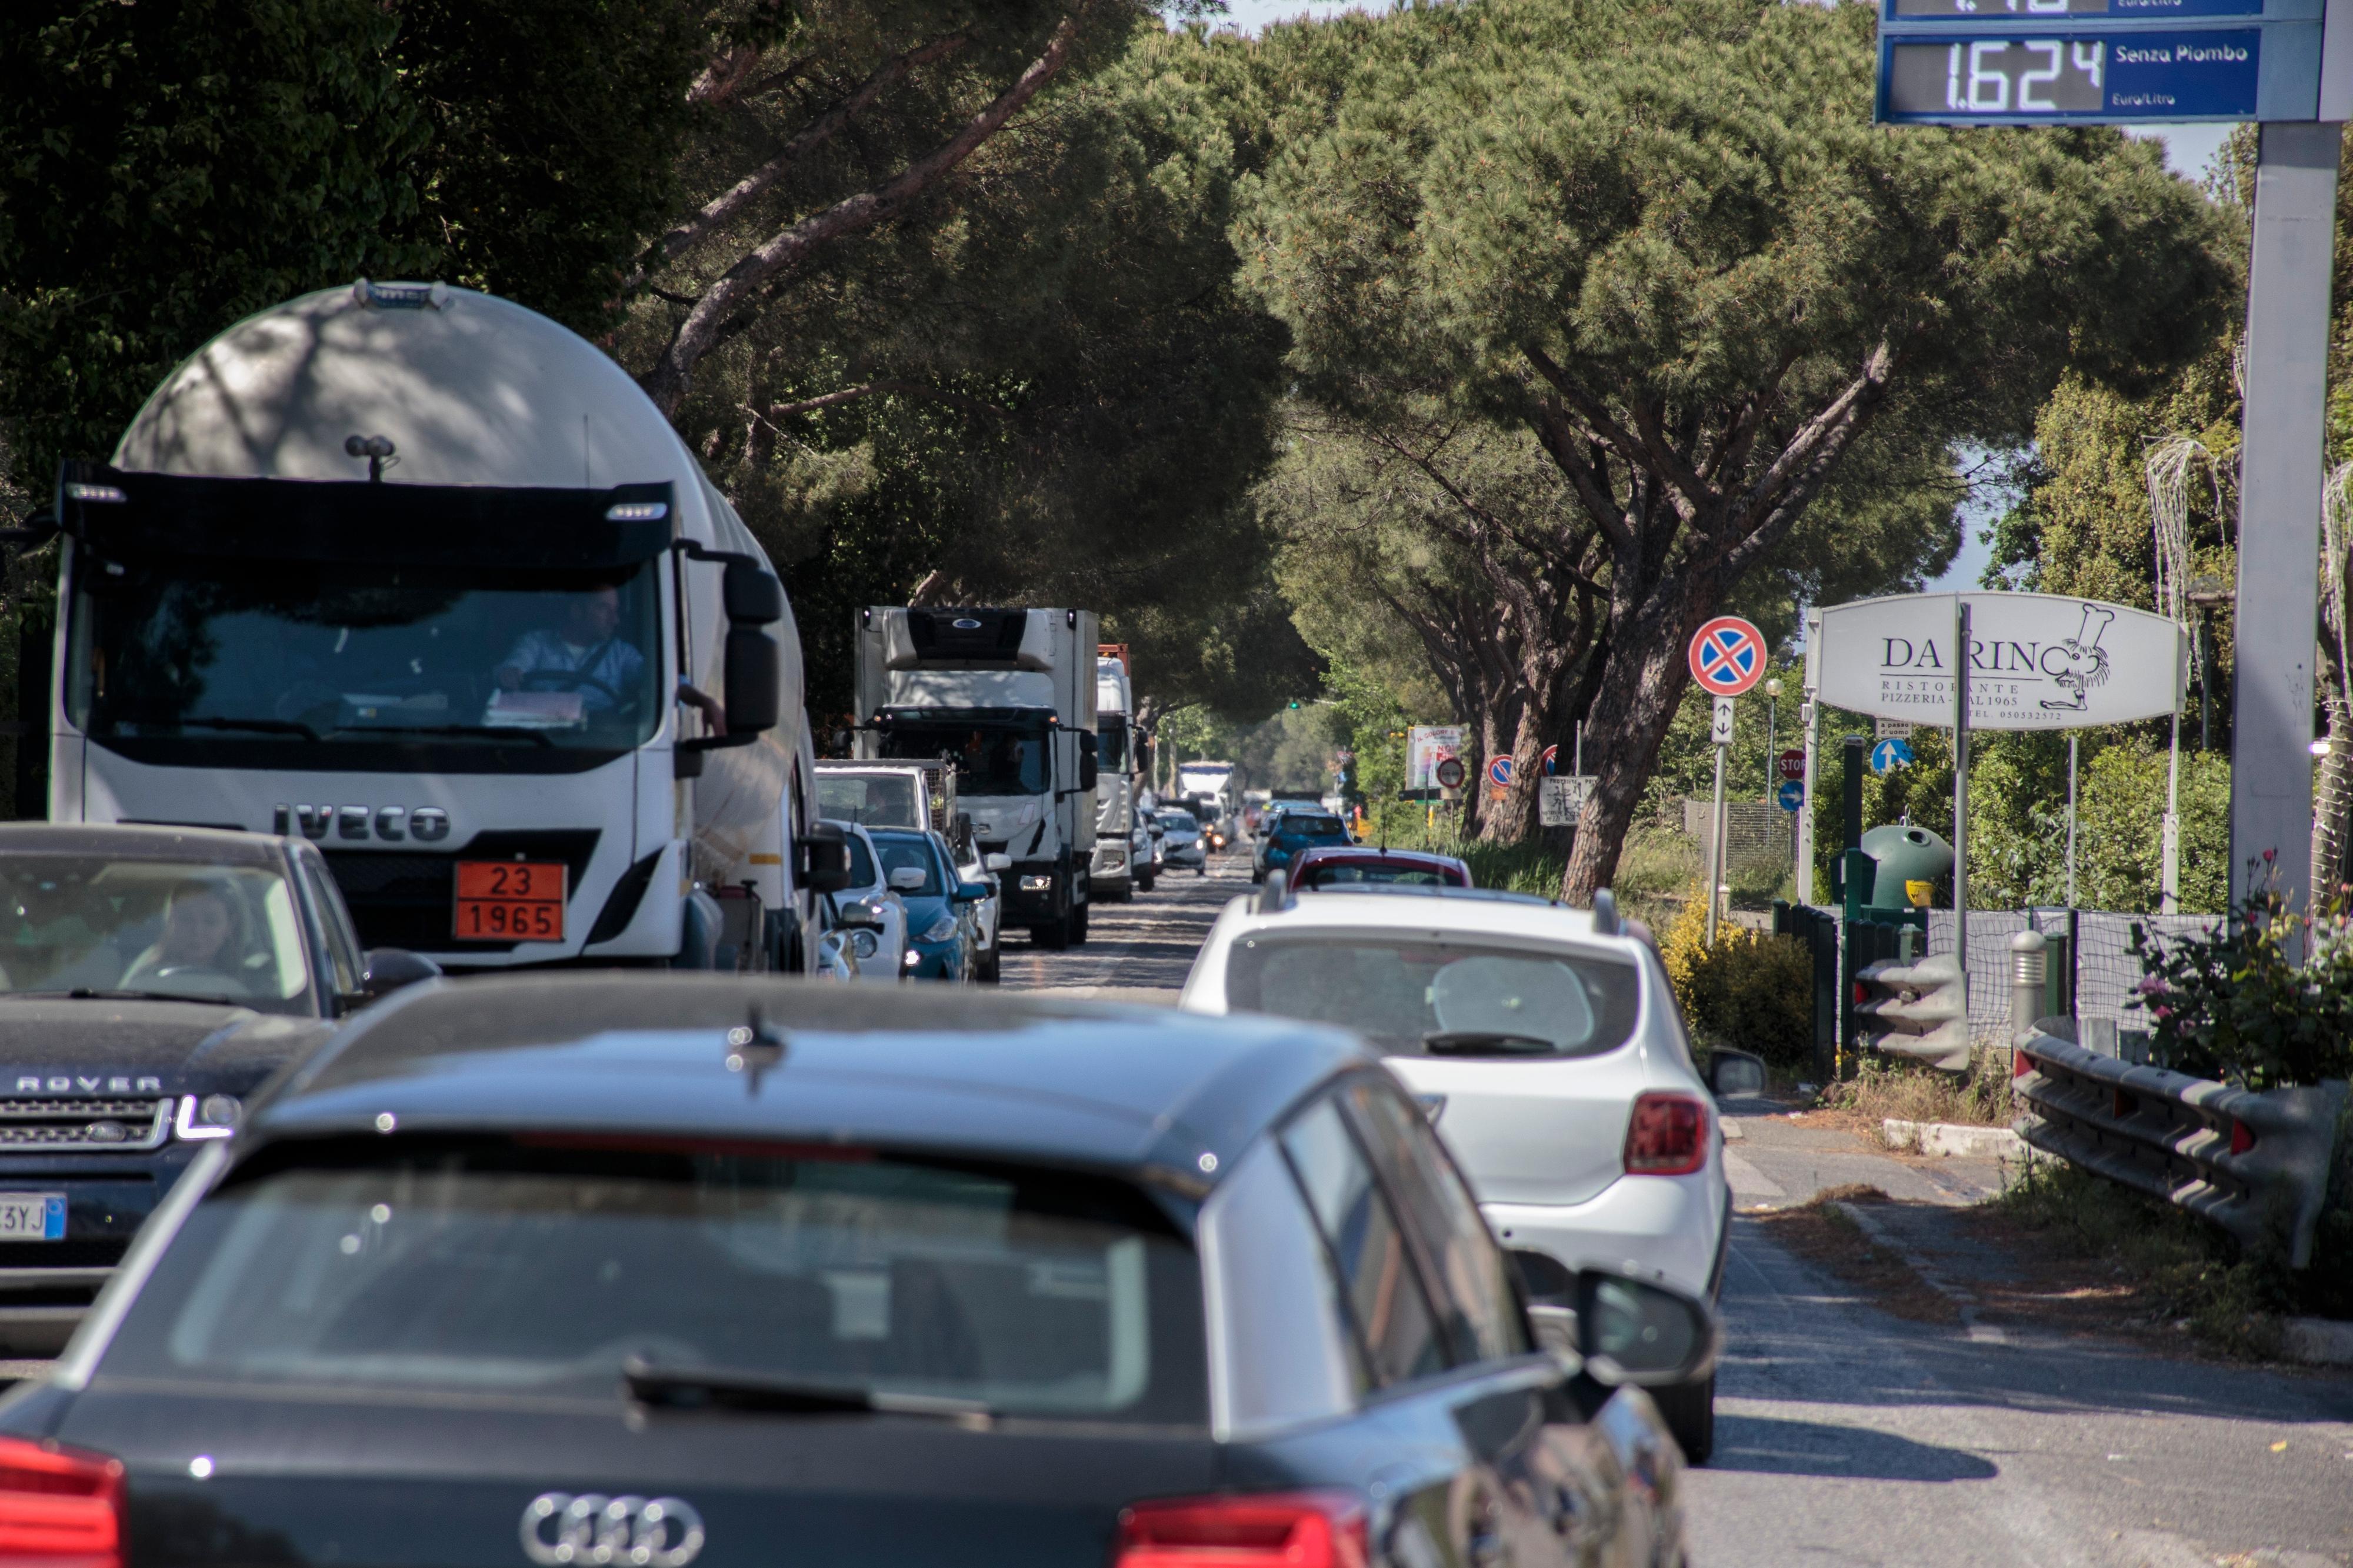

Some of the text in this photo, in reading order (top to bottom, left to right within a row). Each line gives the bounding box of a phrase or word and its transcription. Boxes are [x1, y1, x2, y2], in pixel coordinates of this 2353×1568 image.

[2116, 45, 2248, 63] Senza Piombo
[1947, 40, 2104, 111] 1.624
[2112, 92, 2175, 106] Euro/Litro
[1881, 638, 1944, 668] DA
[1988, 696, 2018, 706] 1965
[2000, 710, 2061, 720] 050532572
[274, 804, 450, 842] IVECO
[491, 867, 531, 895] 23
[471, 905, 552, 935] 1965
[16, 1076, 161, 1091] ROVER
[0, 1205, 44, 1231] 3YJ
